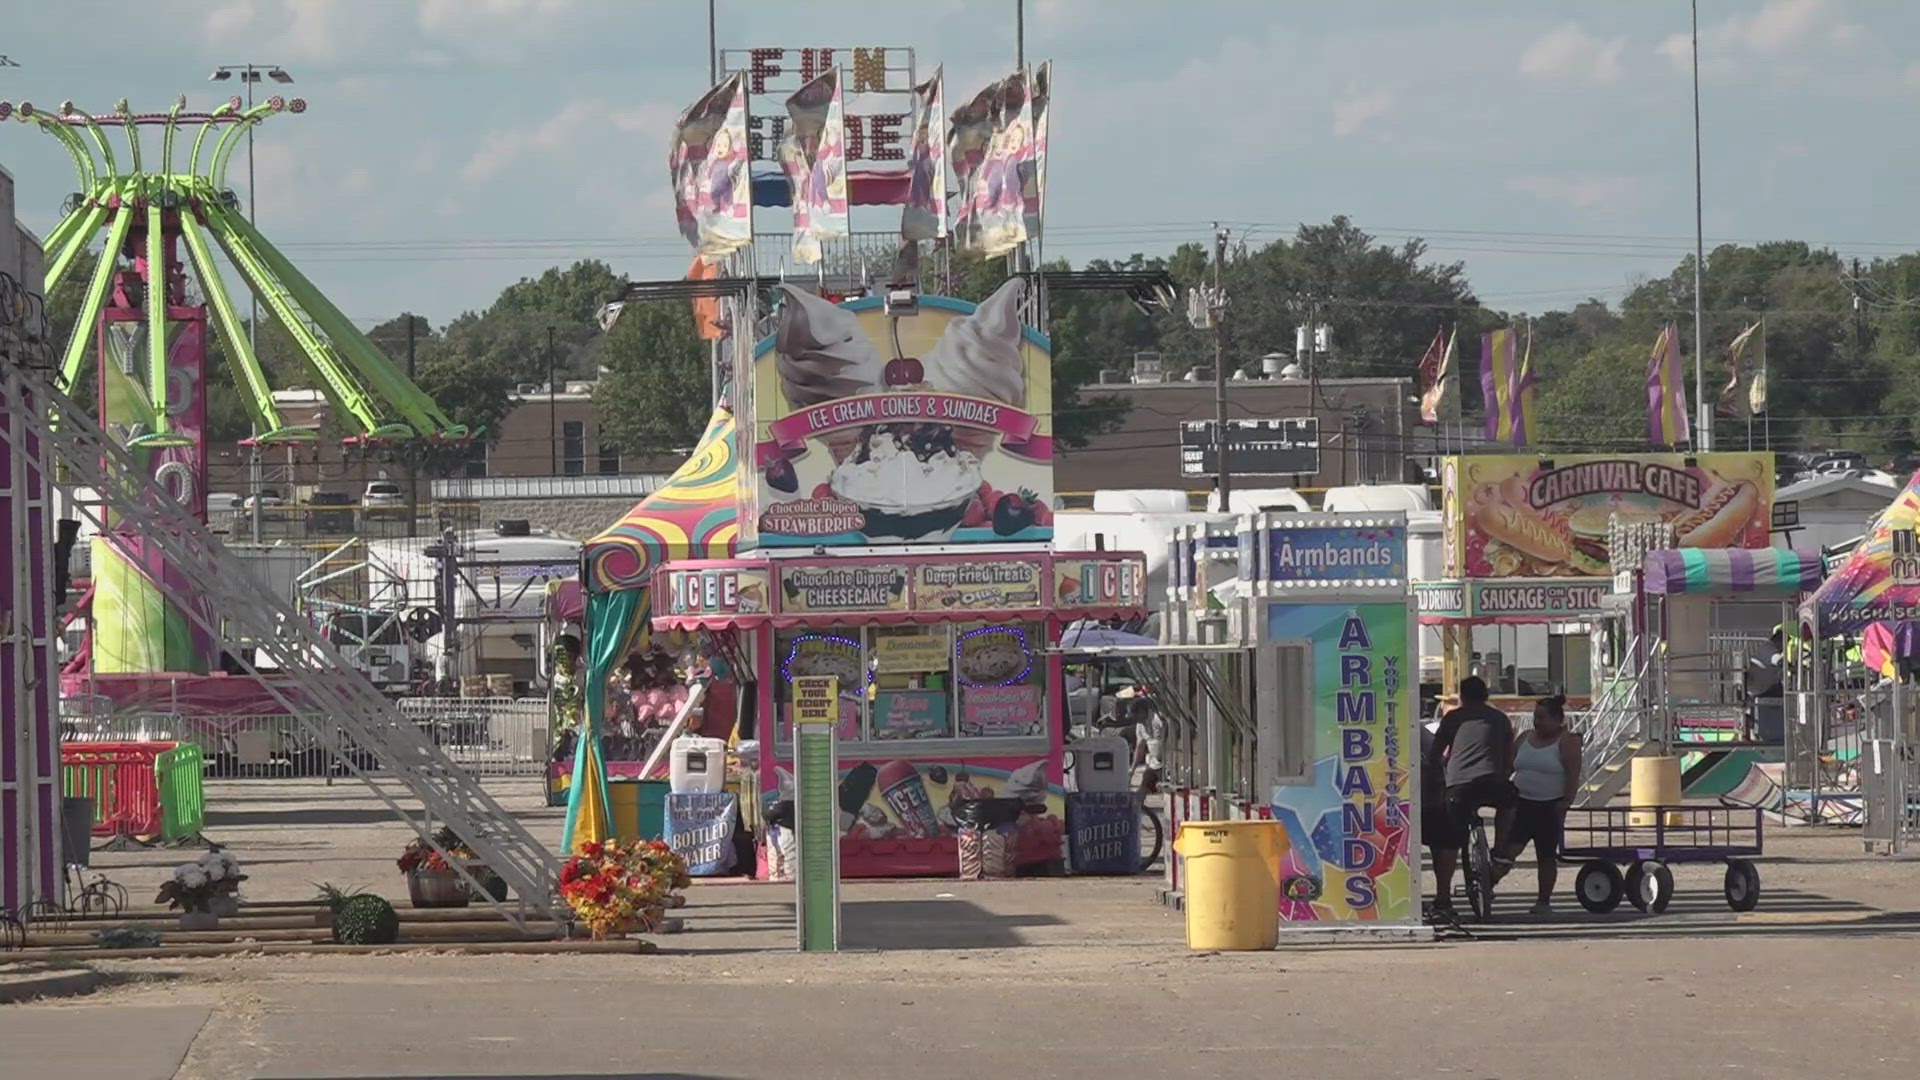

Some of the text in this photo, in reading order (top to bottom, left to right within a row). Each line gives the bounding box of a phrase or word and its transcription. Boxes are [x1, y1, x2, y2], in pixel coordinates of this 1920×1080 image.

[751, 47, 885, 94] FUN
[807, 397, 1000, 431] ICE CREAM CONES & SUNDAES
[1531, 462, 1699, 506] CARNIVAL CAFE
[770, 500, 860, 515] Chocolate Dipped
[764, 517, 864, 535] STRAWBERRIES
[1279, 541, 1392, 567] Armbands
[792, 570, 897, 588] Chocolate Dipped
[924, 565, 1033, 586] Deep Fried Treats
[676, 575, 737, 608] ICEE
[807, 587, 887, 607] CHEESECAKE
[1429, 589, 1462, 610] DRINKS
[1481, 588, 1546, 610] SAUSAGE
[1549, 588, 1565, 597] ON
[798, 680, 829, 689] CHECK
[801, 690, 827, 698] YOUR
[797, 700, 832, 708] HEIGHT
[801, 710, 827, 718] HERE
[1337, 617, 1375, 908] ARMBANDS
[673, 821, 729, 851] BOTTLED
[1078, 820, 1130, 847] BOTTLED
[680, 843, 721, 868] WATER
[1083, 841, 1122, 863] WATER
